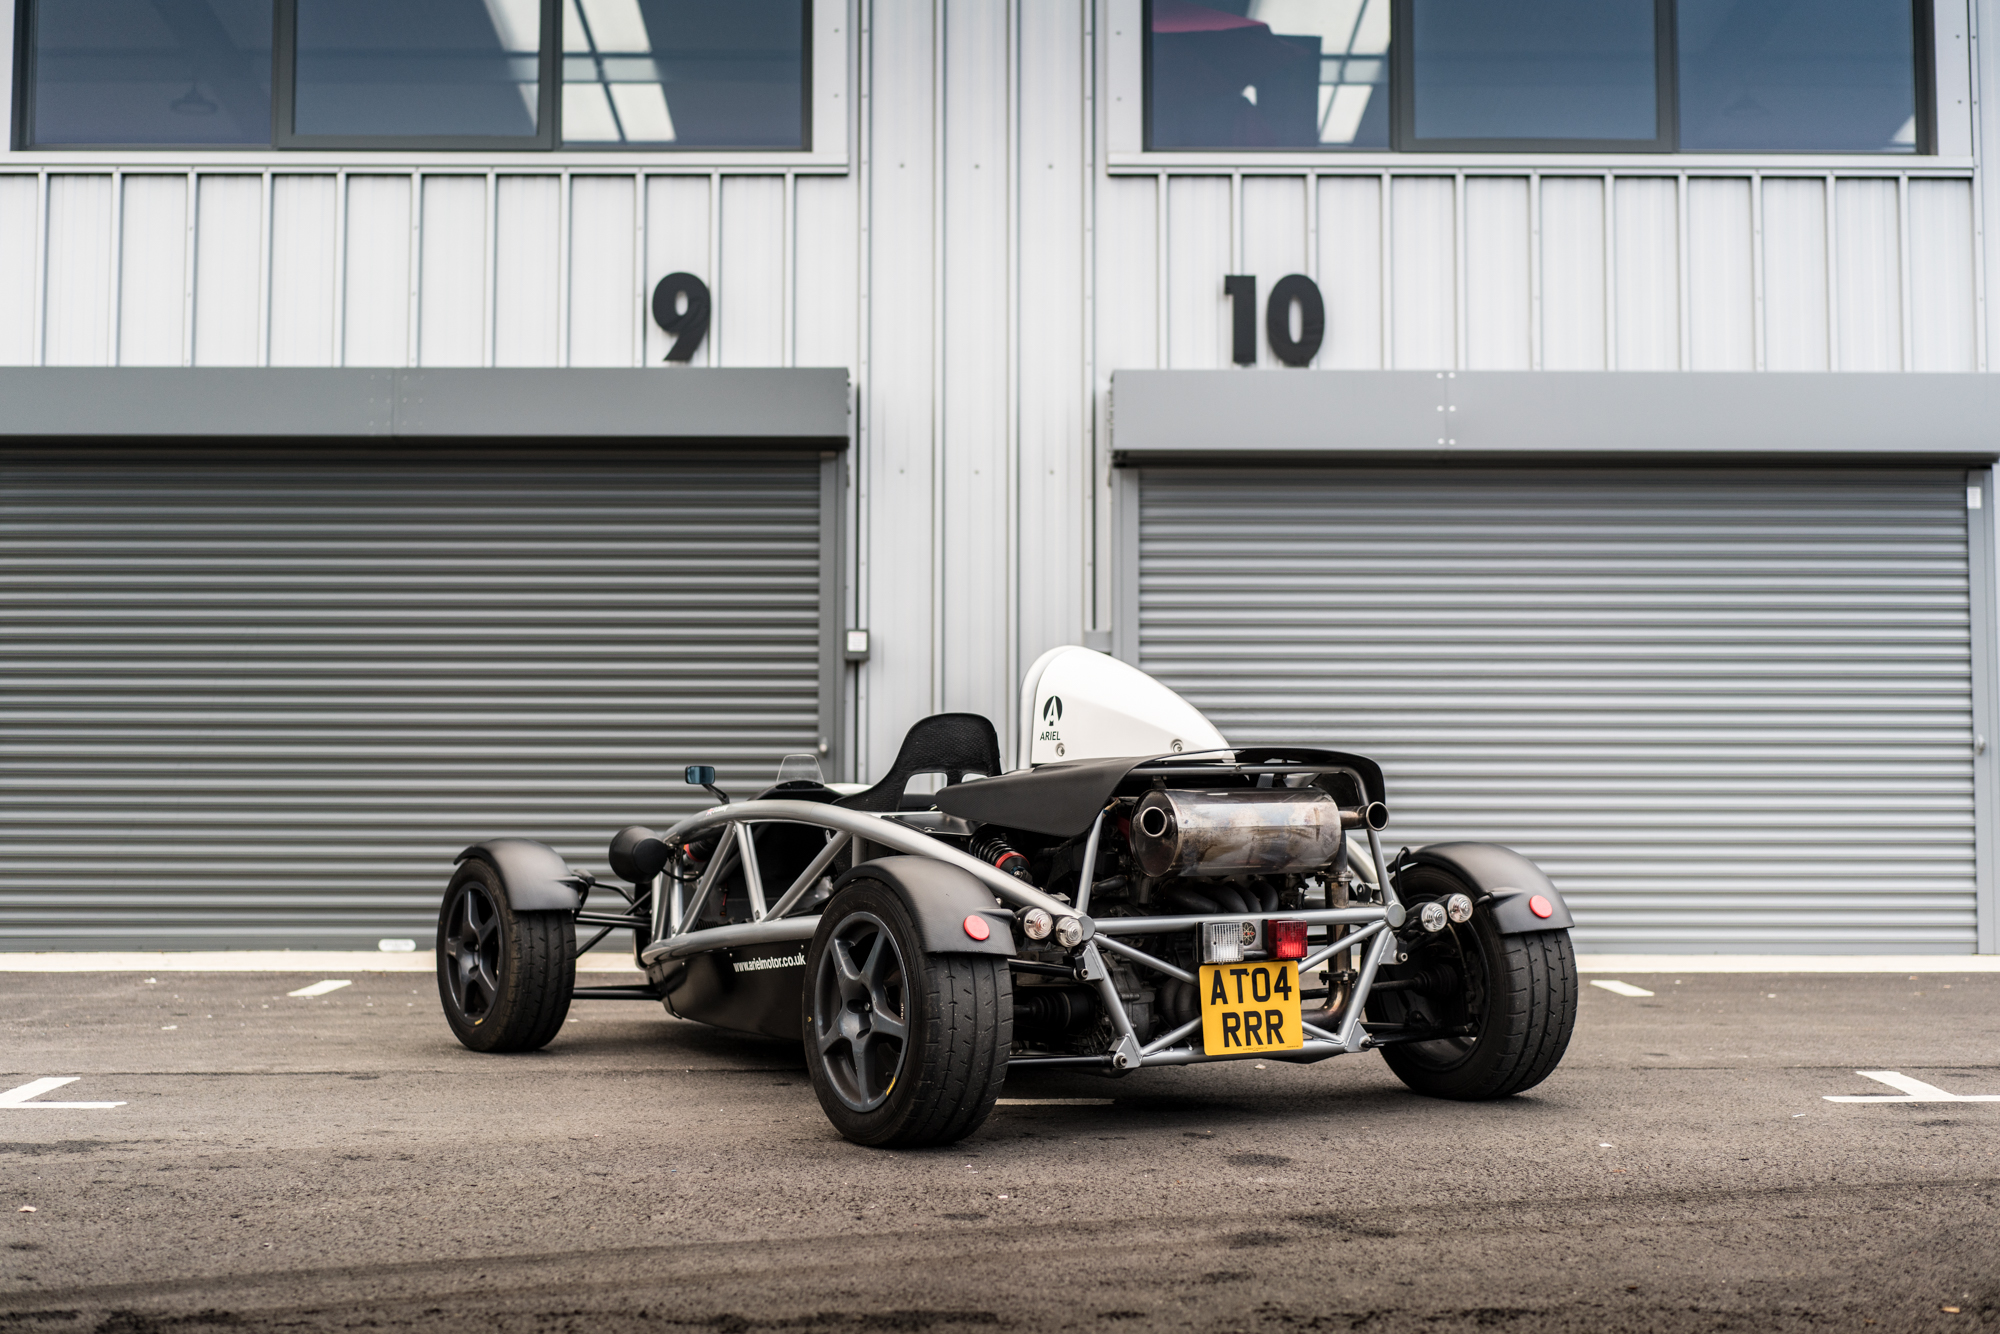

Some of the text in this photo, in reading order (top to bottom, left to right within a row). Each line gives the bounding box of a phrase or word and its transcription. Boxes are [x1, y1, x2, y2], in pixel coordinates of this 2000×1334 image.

[652, 271, 711, 364] 9
[1225, 273, 1325, 367] 10
[1039, 731, 1061, 741] ARIEL
[733, 952, 806, 973] www.arielmotor.co.uk
[1210, 966, 1292, 1006] AT04
[1222, 1009, 1285, 1048] RRR
